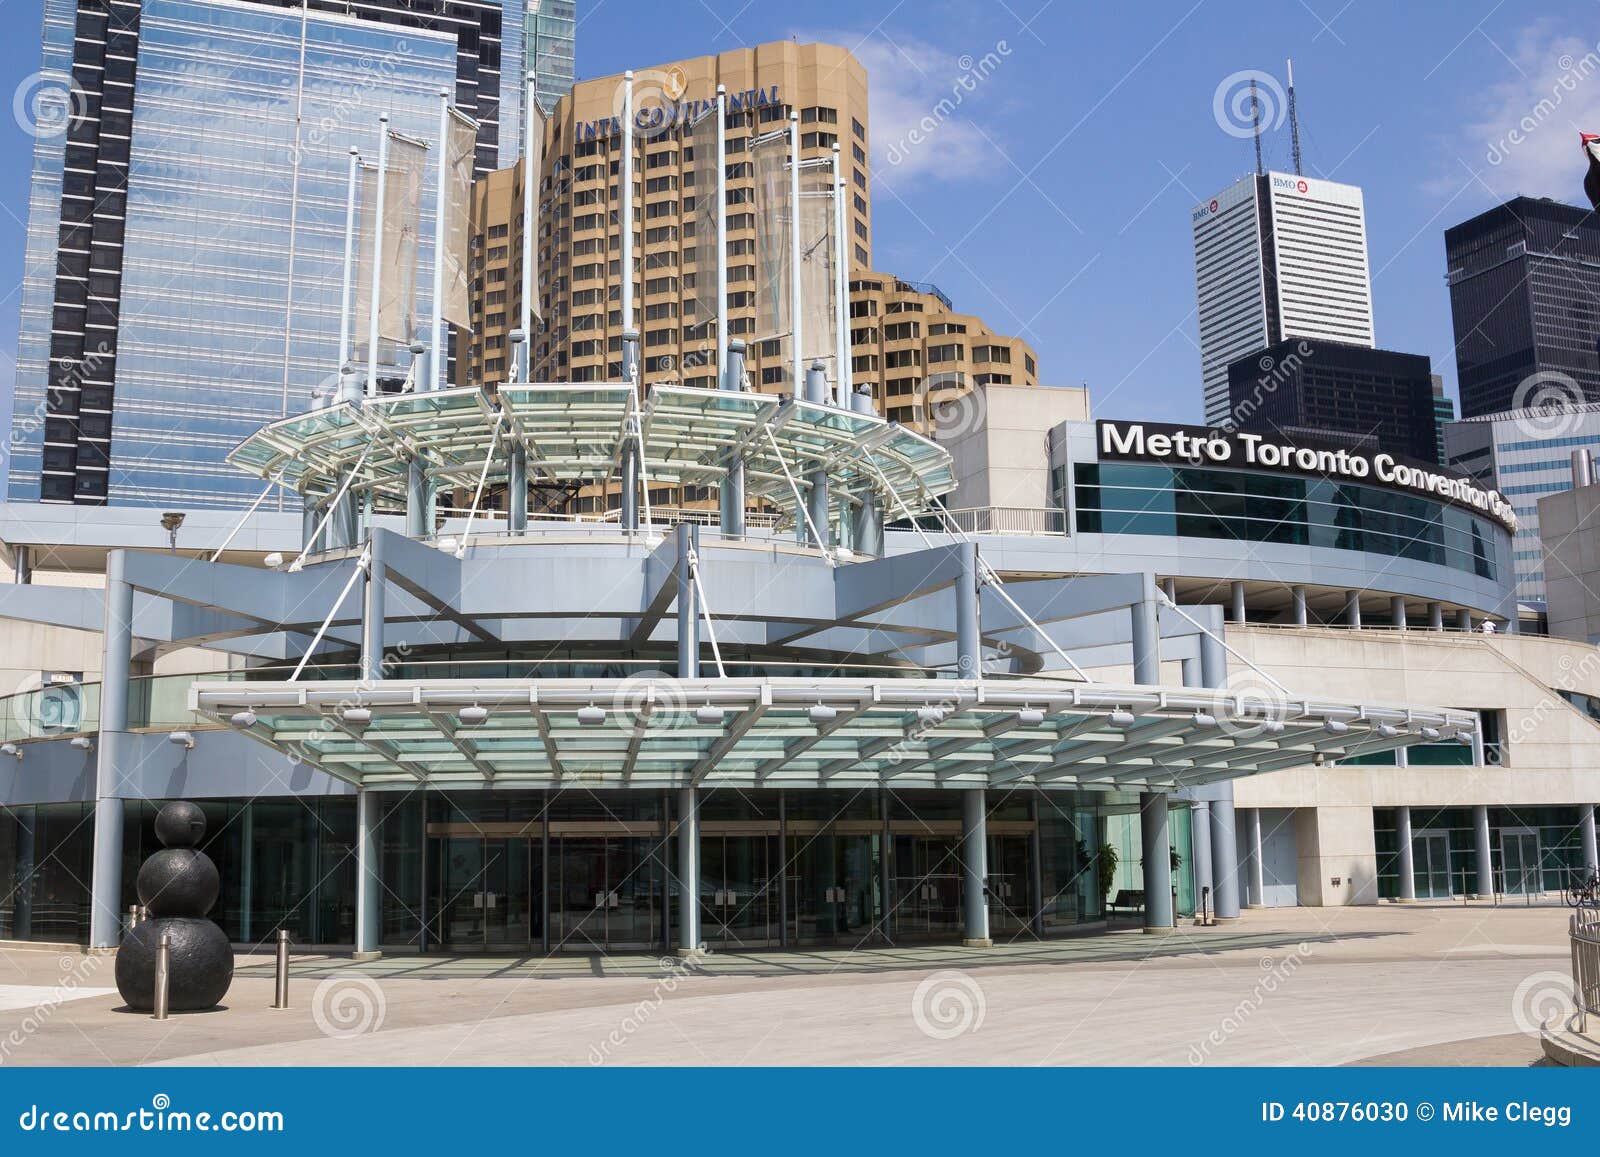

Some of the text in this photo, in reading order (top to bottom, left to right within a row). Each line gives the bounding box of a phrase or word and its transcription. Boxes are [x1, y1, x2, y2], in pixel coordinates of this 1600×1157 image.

[1273, 177, 1296, 190] BMO
[1193, 206, 1209, 222] BMO
[1101, 422, 1232, 462] Metro
[1237, 432, 1370, 478] Toronto
[1374, 453, 1489, 511] Convention
